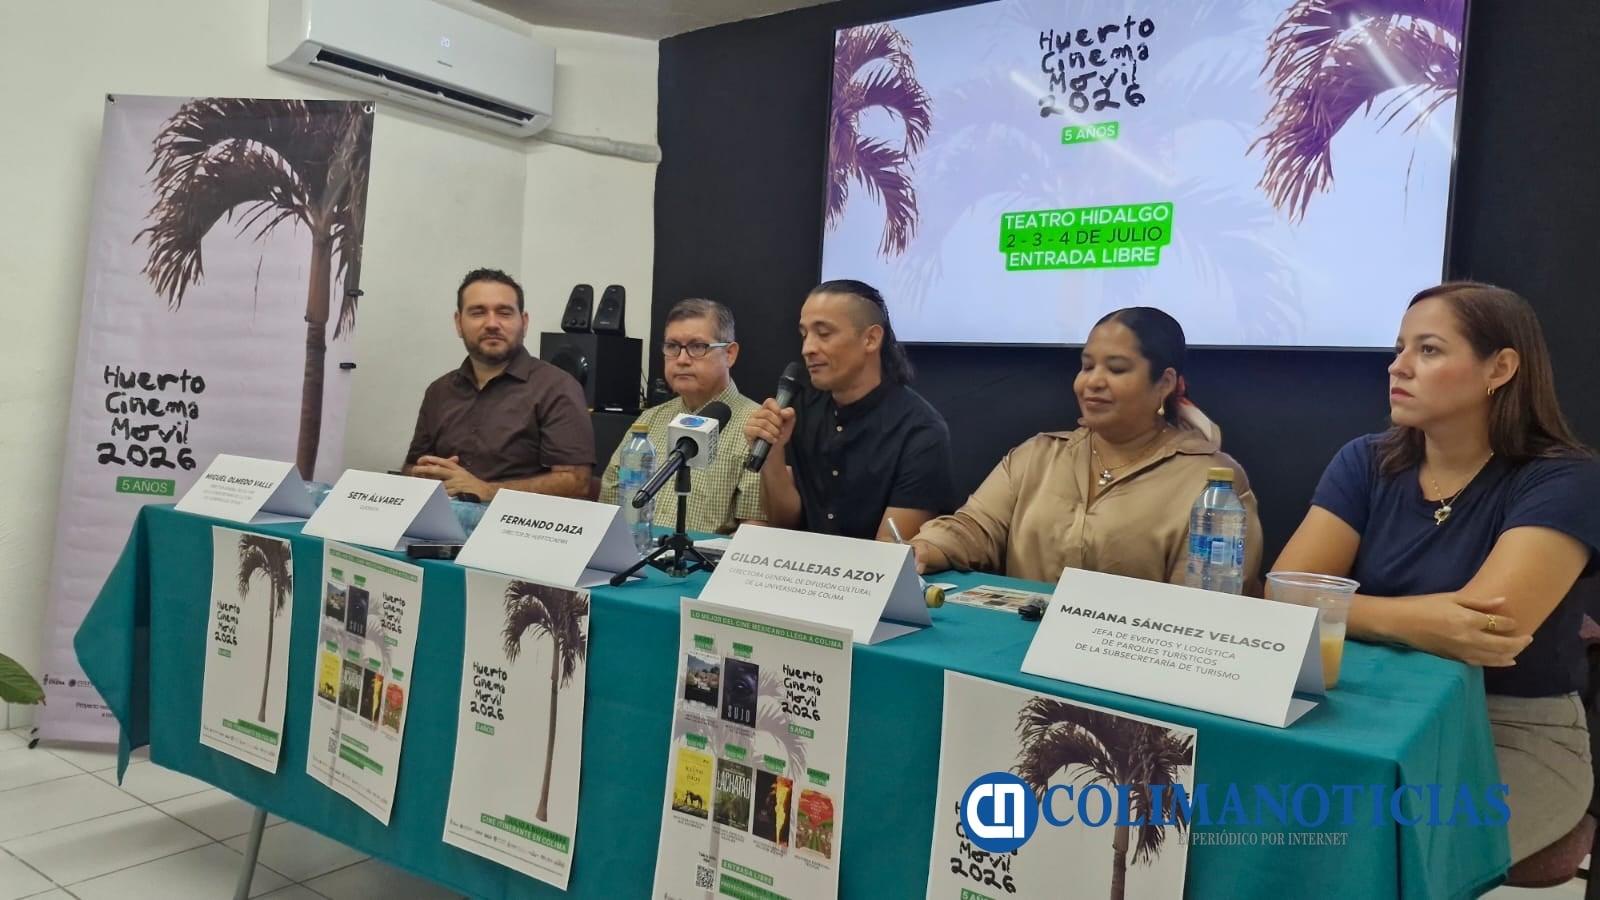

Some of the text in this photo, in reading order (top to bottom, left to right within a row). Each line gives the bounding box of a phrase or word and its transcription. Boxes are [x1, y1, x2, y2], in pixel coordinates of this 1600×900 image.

[1039, 15, 1155, 52] Huerto
[1042, 42, 1149, 73] Cinema
[1038, 84, 1146, 118] 2026
[1065, 129, 1072, 141] 5
[1005, 205, 1169, 230] TEATRO HIDALGO
[1006, 234, 1016, 248] 2
[1032, 232, 1042, 246] 3
[1059, 231, 1070, 245] 4
[1076, 230, 1100, 244] DE
[1106, 226, 1163, 244] JULIO
[1009, 246, 1156, 267] ENTRADA LIBRE
[104, 365, 205, 393] Huerto
[106, 392, 198, 420] Cinema
[96, 443, 196, 471] 2026
[122, 479, 168, 492] 5 AÑOS
[206, 473, 274, 489] MIGUEL OLMEDO VALLE
[347, 491, 405, 505] SETH ÁLVAREZ
[500, 514, 583, 535] FERNANDO DAZA
[730, 552, 884, 583] GILDA CALLEJAS AZOY
[729, 567, 765, 578] DIRECTORA
[765, 574, 793, 583] GENERAL
[805, 578, 837, 590] DIFUSIÓN
[838, 585, 872, 596] CULTURAL
[765, 583, 806, 595] UNIVERSIDAD
[818, 591, 844, 600] COLIMA
[1060, 604, 1285, 652] MARIANA SÁNCHEZ VELASCO
[786, 631, 807, 642] LLEGA
[814, 637, 842, 649] COLIMA
[1092, 628, 1113, 637] JEFA
[1130, 634, 1173, 648] EVENTOS
[1184, 644, 1235, 659] LOGÍSTICA
[1075, 642, 1087, 651] DE
[1103, 648, 1175, 667] SUBSECRETARÍA
[1178, 663, 1192, 671] DE
[1195, 666, 1241, 680] TURISMO
[1101, 638, 1217, 666] DE PARQUES TURÍSTICOS
[473, 661, 507, 681] Huerto
[783, 664, 823, 684] Huerto
[474, 675, 505, 694] Cinema
[784, 677, 821, 696] Cinema
[470, 701, 504, 720] 2026
[727, 704, 750, 723] SUJO
[781, 701, 821, 721] 2026
[717, 770, 751, 800] LACHATAO
[950, 857, 1016, 894] 2026
